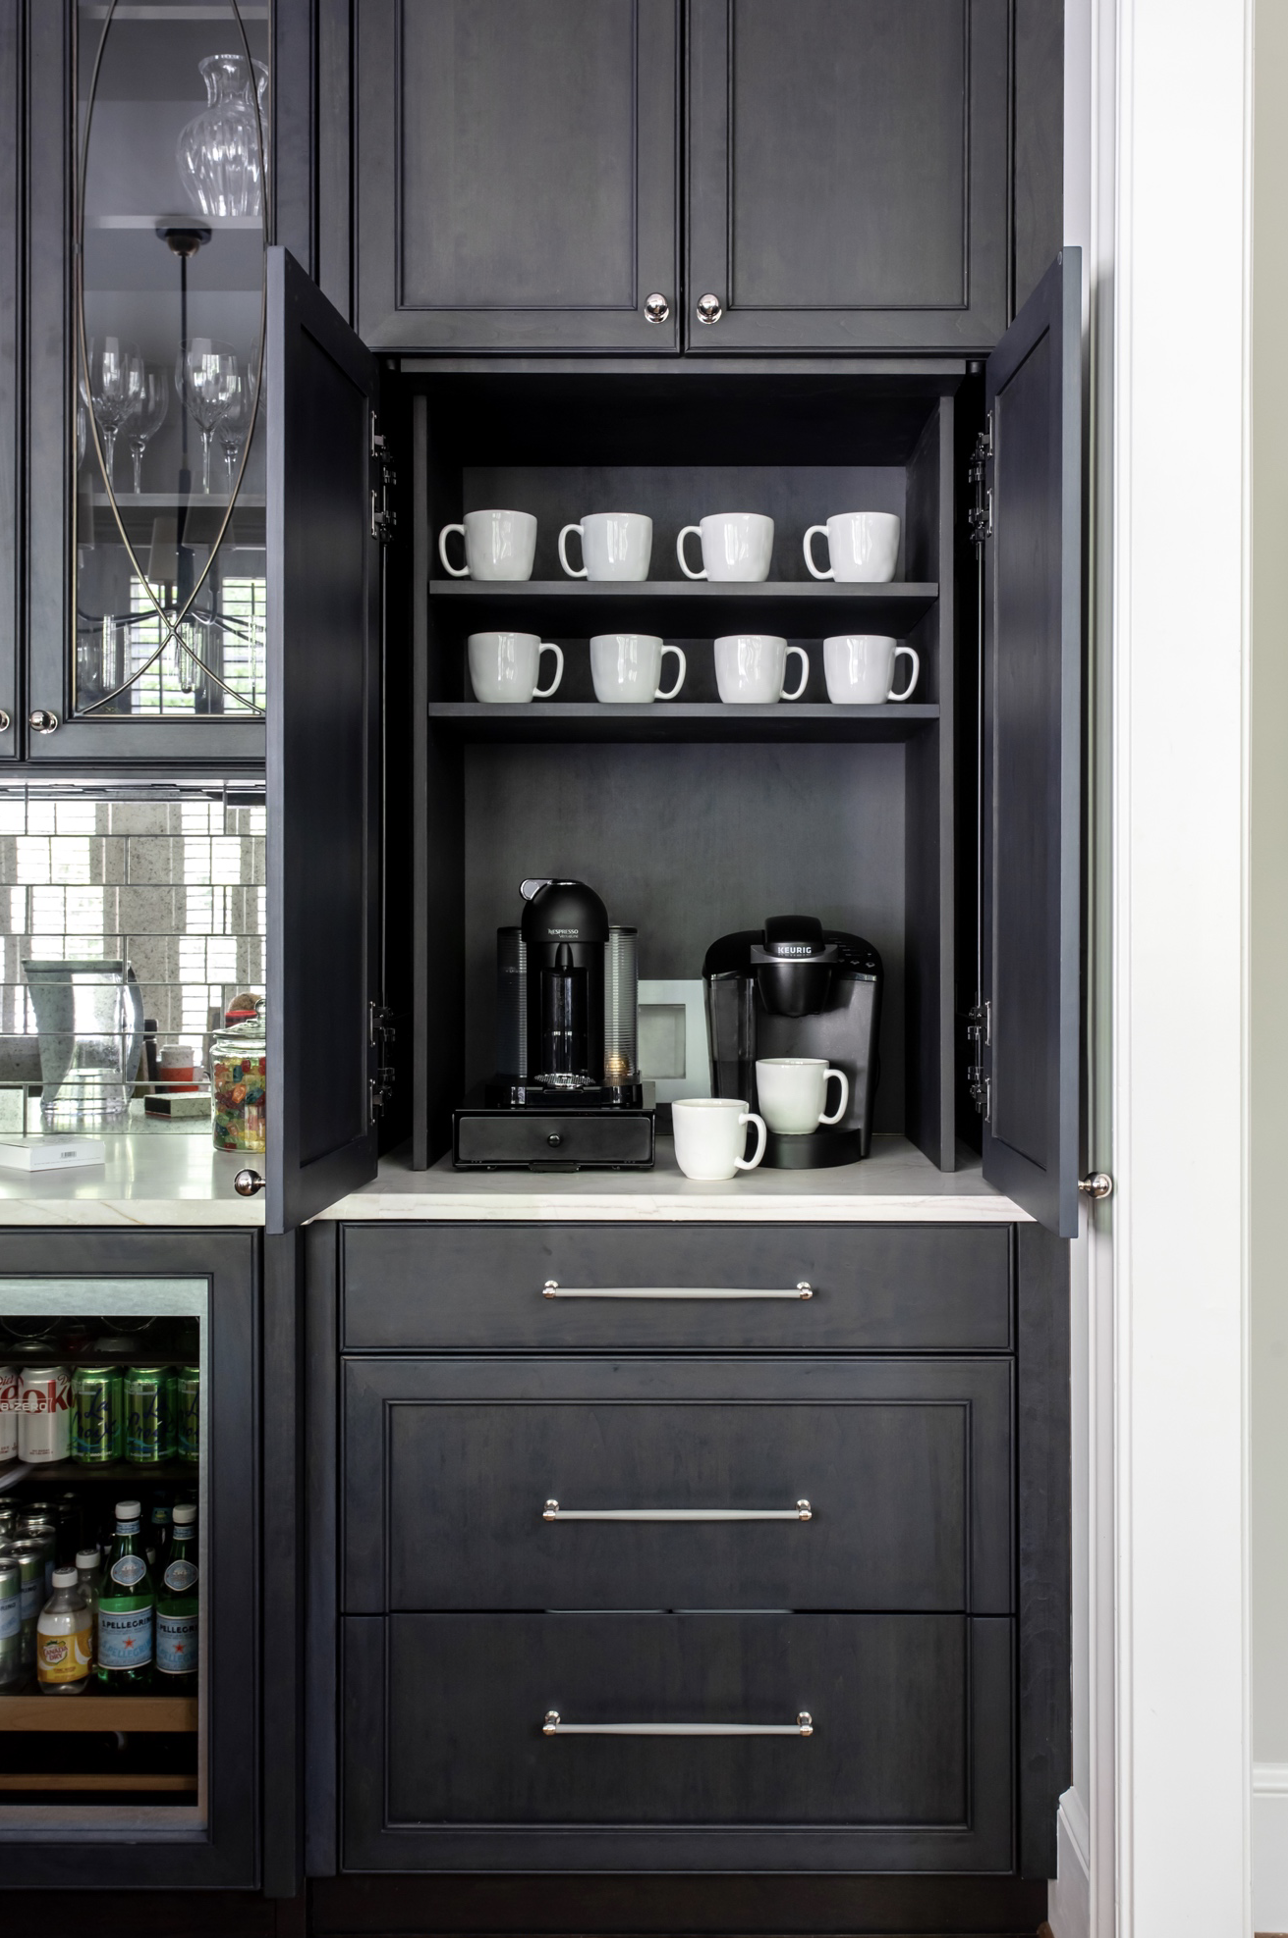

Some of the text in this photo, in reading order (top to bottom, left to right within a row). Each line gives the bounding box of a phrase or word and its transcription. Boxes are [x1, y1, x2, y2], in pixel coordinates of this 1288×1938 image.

[778, 946, 812, 954] KEURIG
[102, 1616, 153, 1629] S.PELLEGRIN
[43, 1645, 68, 1657] CANADA
[49, 1653, 62, 1661] DRY
